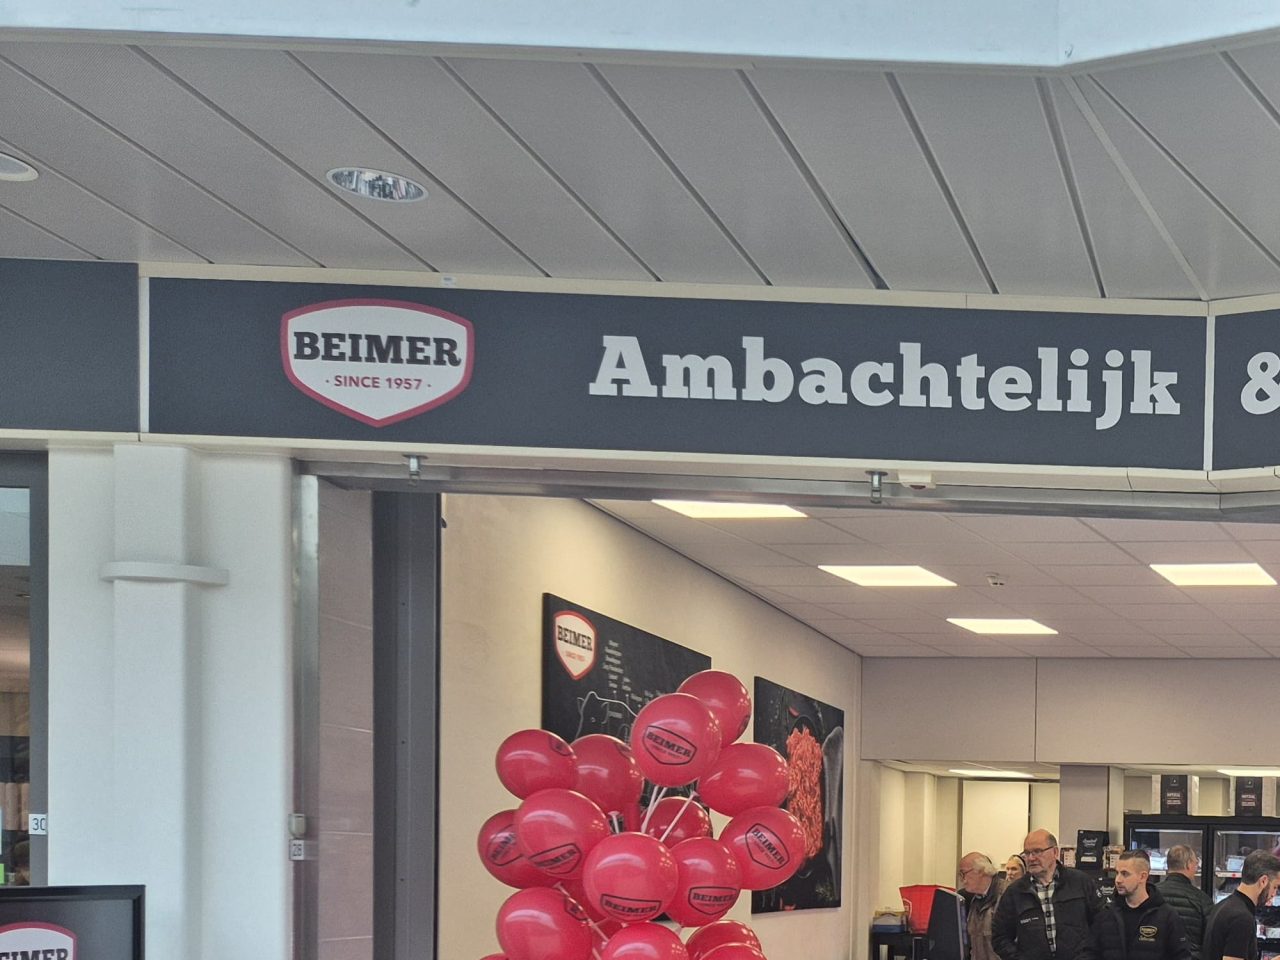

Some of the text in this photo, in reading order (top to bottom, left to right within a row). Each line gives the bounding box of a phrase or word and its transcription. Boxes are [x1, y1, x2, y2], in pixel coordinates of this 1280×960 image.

[293, 331, 463, 368] BEIMER
[333, 373, 424, 391] SINCE 1957
[589, 335, 1181, 430] Ambachtelijk
[557, 624, 593, 652] BEIMER
[646, 731, 692, 757] BEIMER
[751, 827, 785, 865] BEIMER
[603, 899, 657, 914] BEIMER
